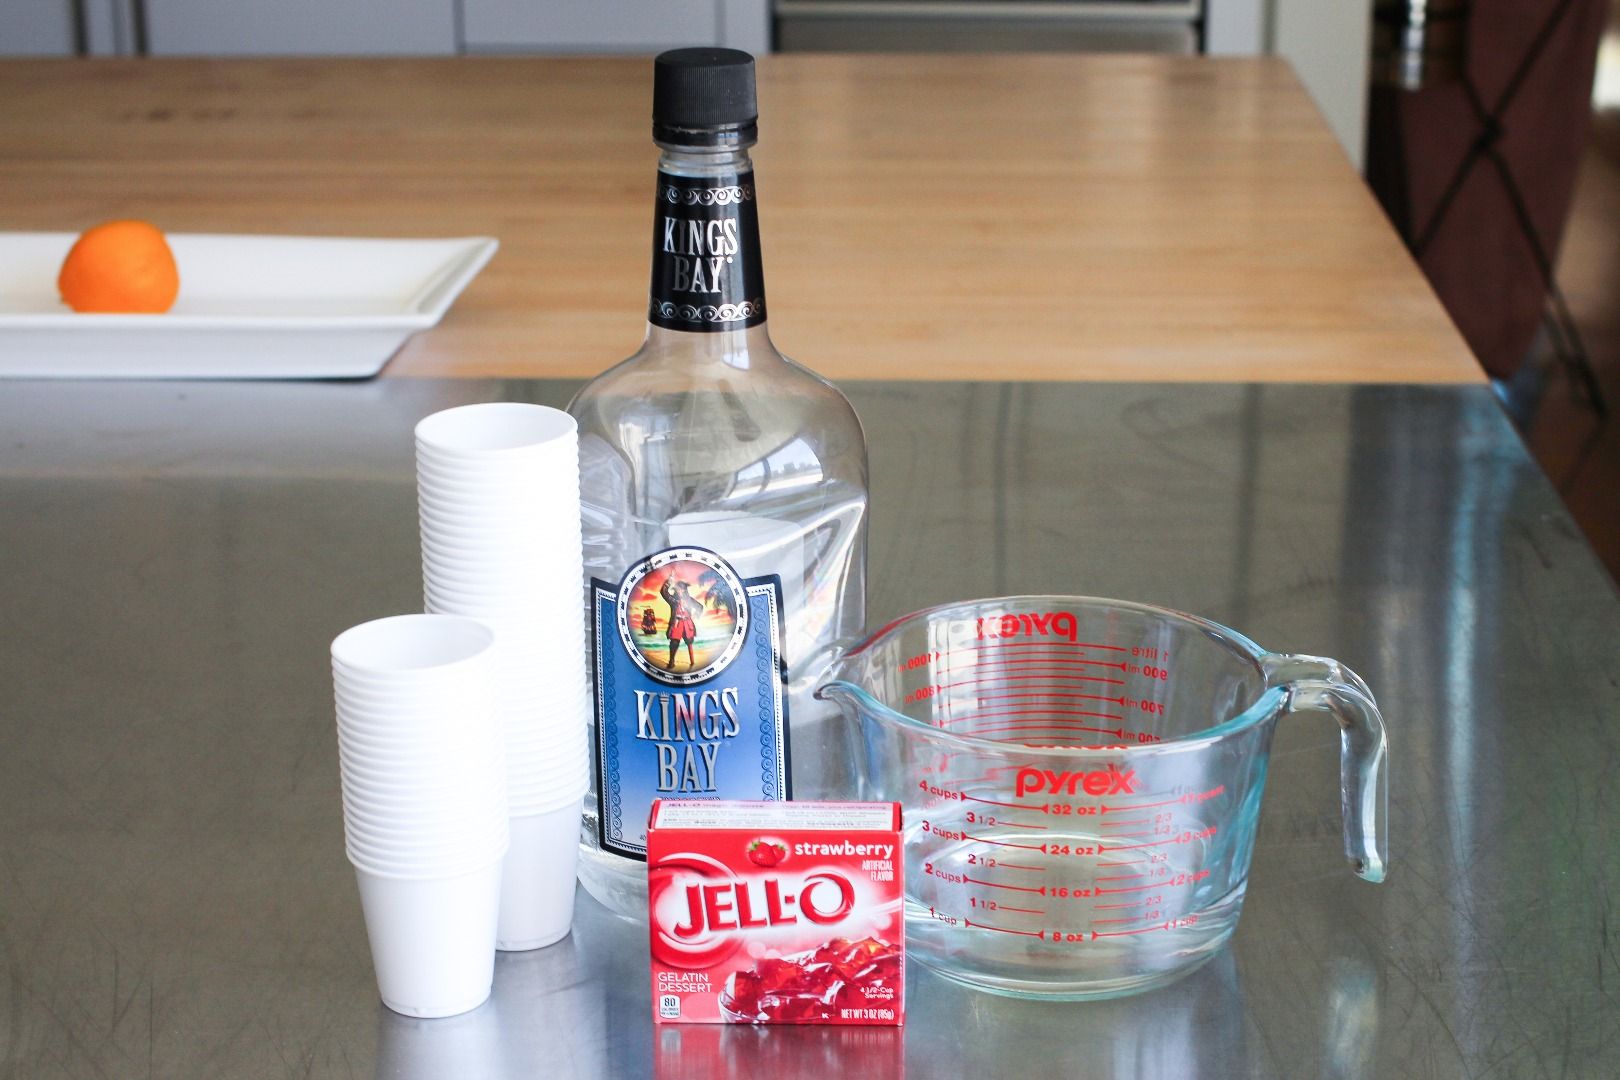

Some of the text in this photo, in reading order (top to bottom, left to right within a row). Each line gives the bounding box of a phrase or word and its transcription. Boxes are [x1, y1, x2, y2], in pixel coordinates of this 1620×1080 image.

[663, 216, 738, 256] KINGS
[672, 256, 724, 293] BAY
[633, 687, 741, 742] KINGS
[656, 742, 721, 793] BAY
[919, 780, 958, 800] 4 cups
[1016, 767, 1135, 798] pyrex
[1052, 804, 1096, 815] 32 oz
[966, 812, 996, 826] 3 1/2
[922, 820, 960, 840] 3 cups
[795, 840, 894, 859] strawberry
[1050, 845, 1094, 855] 24 oz
[968, 854, 996, 868] 2 1/2
[924, 863, 961, 884] 2 cups
[1050, 888, 1090, 898] 16 oz
[674, 872, 855, 938] JELL-O
[970, 897, 997, 911] 1 1/2
[930, 906, 957, 926] 1 cup
[1052, 932, 1084, 942] 8 oz
[658, 972, 709, 982] GELATIN
[658, 982, 712, 992] DESSERT
[664, 998, 676, 1006] 80
[841, 1009, 852, 1018] NET
[853, 1009, 862, 1018] WT
[864, 1009, 868, 1018] 3
